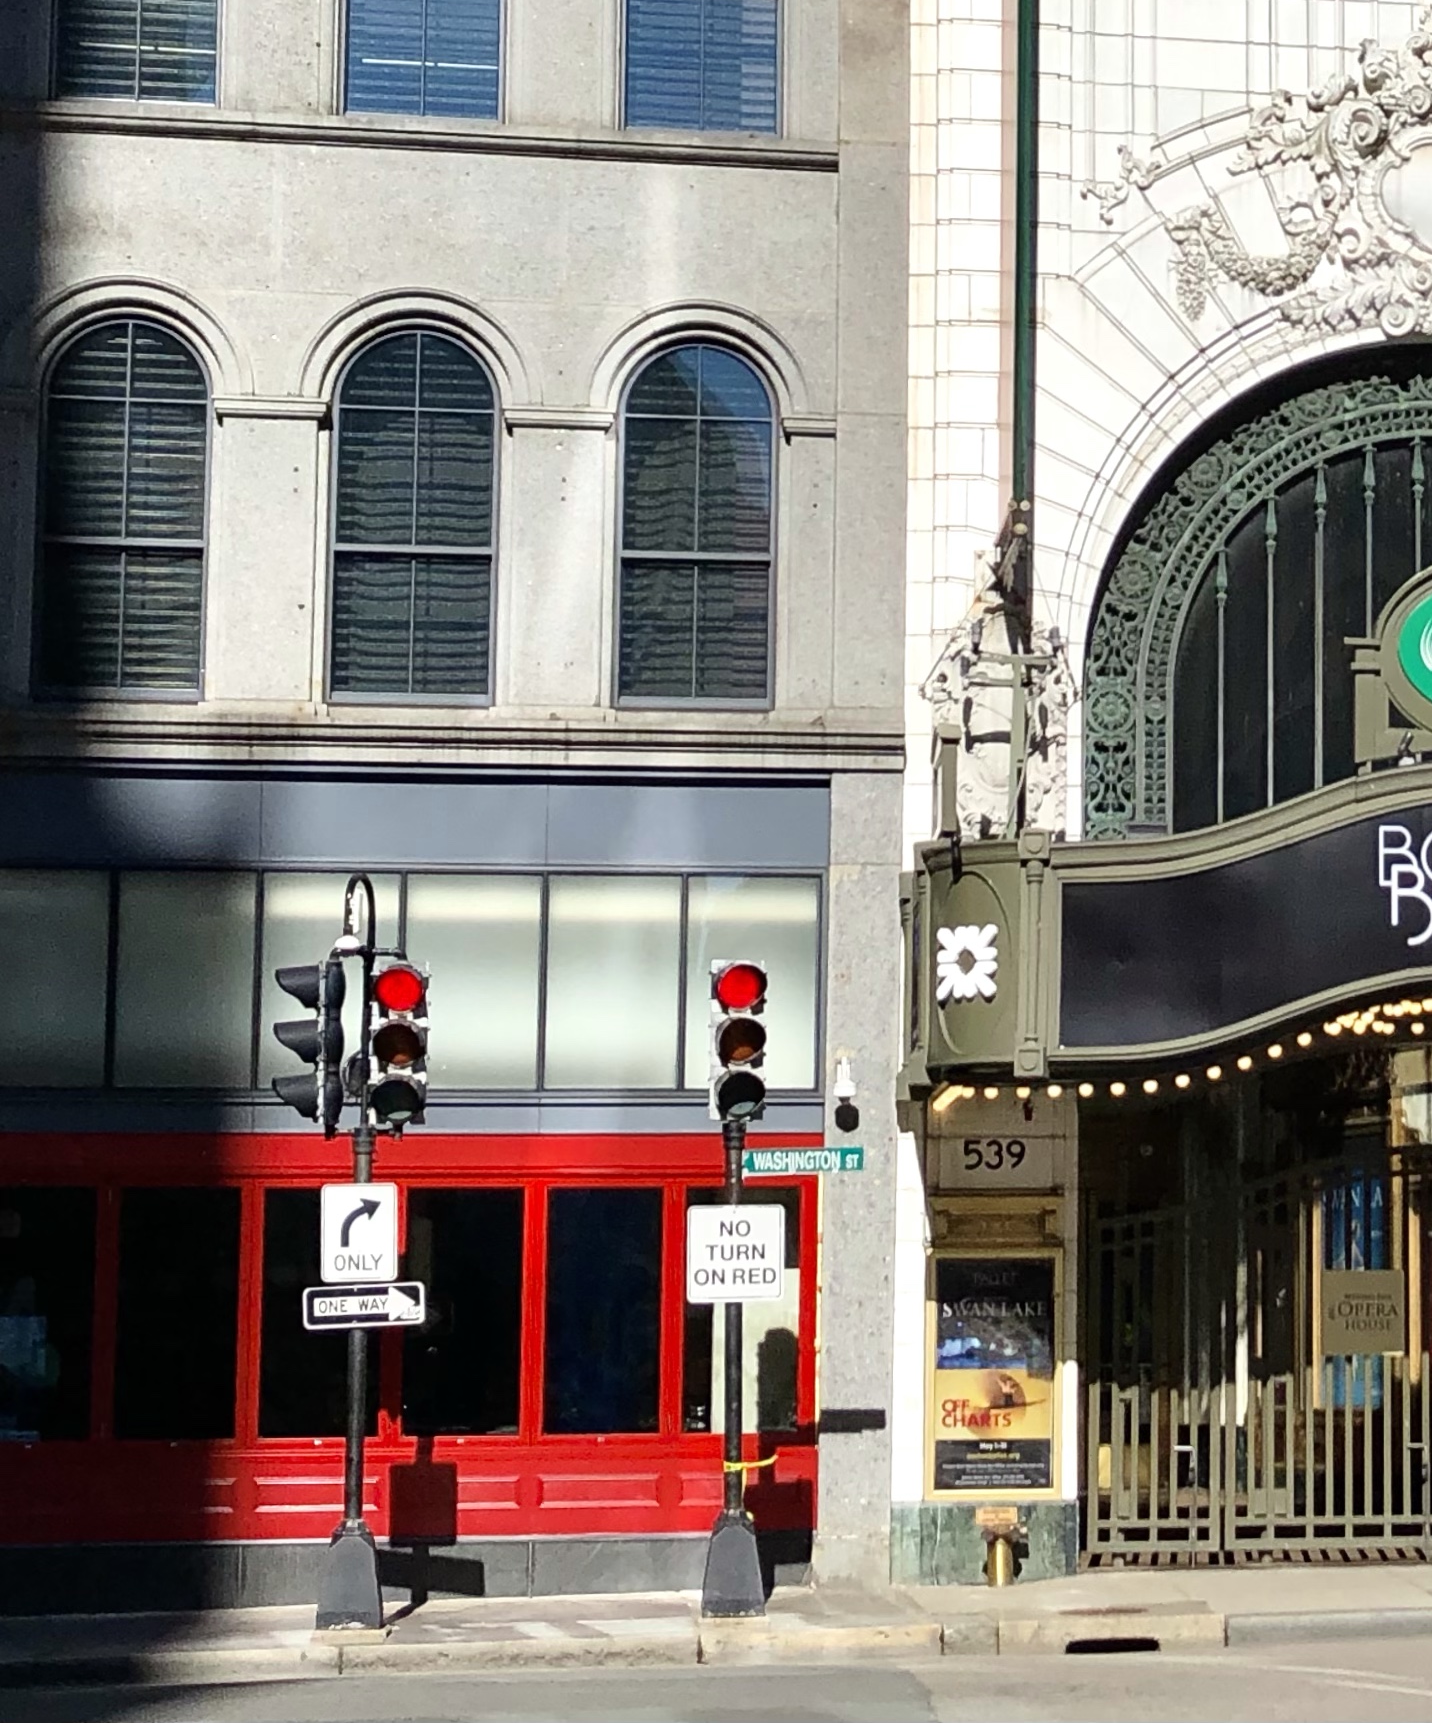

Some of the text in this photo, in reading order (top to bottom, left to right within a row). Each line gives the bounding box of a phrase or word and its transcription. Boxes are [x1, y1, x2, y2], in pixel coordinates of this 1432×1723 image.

[753, 1150, 860, 1171] WASHINGTON ST
[963, 1139, 1026, 1170] 539
[719, 1220, 751, 1237] NO
[706, 1243, 766, 1262] TURN
[334, 1253, 384, 1272] ONLY
[694, 1267, 776, 1286] ON RED
[318, 1300, 348, 1314] ONE
[358, 1298, 389, 1313] WAY
[942, 1298, 1047, 1317] SWAN LAKE
[1338, 1301, 1398, 1317] OPERA
[942, 1399, 970, 1413] OFF
[942, 1412, 1012, 1428] CHARTS
